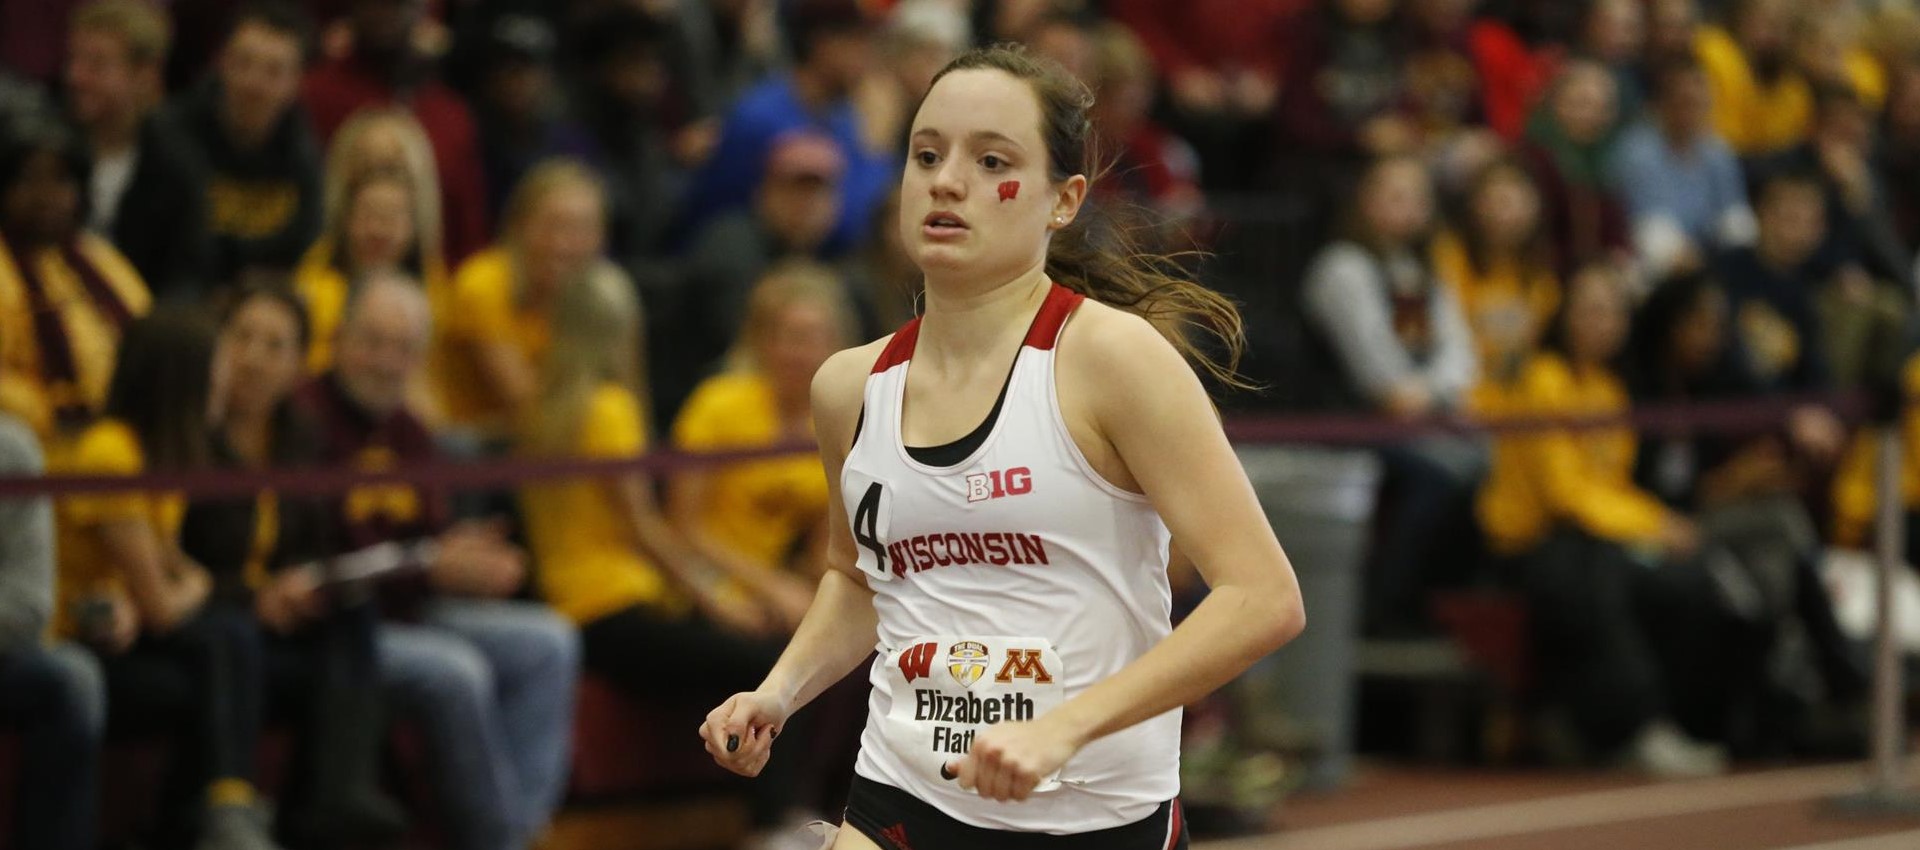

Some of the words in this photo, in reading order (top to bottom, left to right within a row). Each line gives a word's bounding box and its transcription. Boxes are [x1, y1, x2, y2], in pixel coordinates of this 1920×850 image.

[854, 481, 887, 573] 4
[888, 532, 1049, 579] WISCONSIN
[898, 642, 938, 684] W
[995, 648, 1053, 684] M
[915, 689, 1034, 724] Elizabeth
